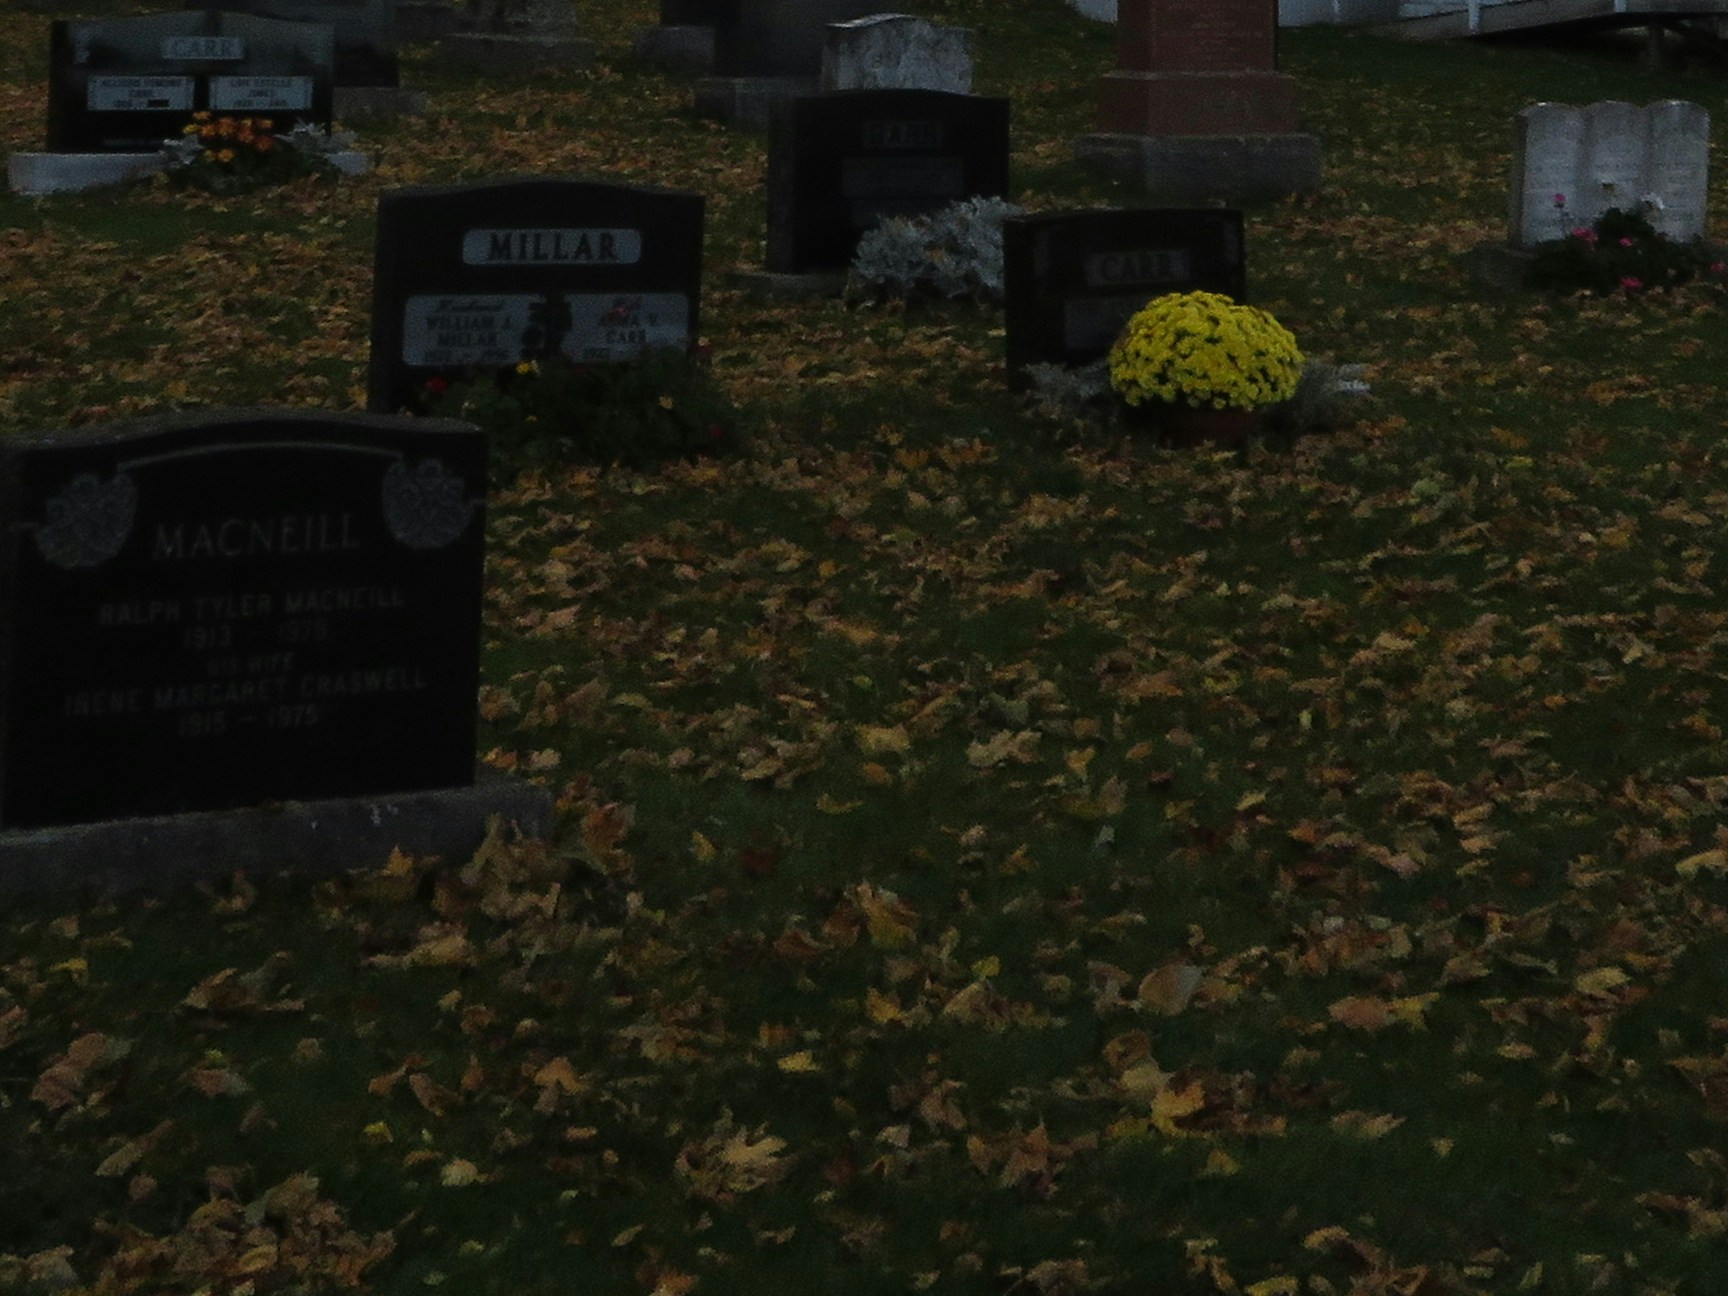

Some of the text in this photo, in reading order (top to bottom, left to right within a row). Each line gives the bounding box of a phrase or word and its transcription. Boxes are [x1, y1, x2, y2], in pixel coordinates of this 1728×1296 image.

[487, 232, 619, 262] MILLAR
[153, 512, 360, 560] MACNEILL
[97, 585, 406, 626] RALPH TYLER MACNEILL
[248, 651, 296, 675] WIFE
[63, 666, 428, 718] IRENE MARGARET CRASWELL
[177, 709, 228, 737] 1915
[267, 701, 320, 730] 1975
